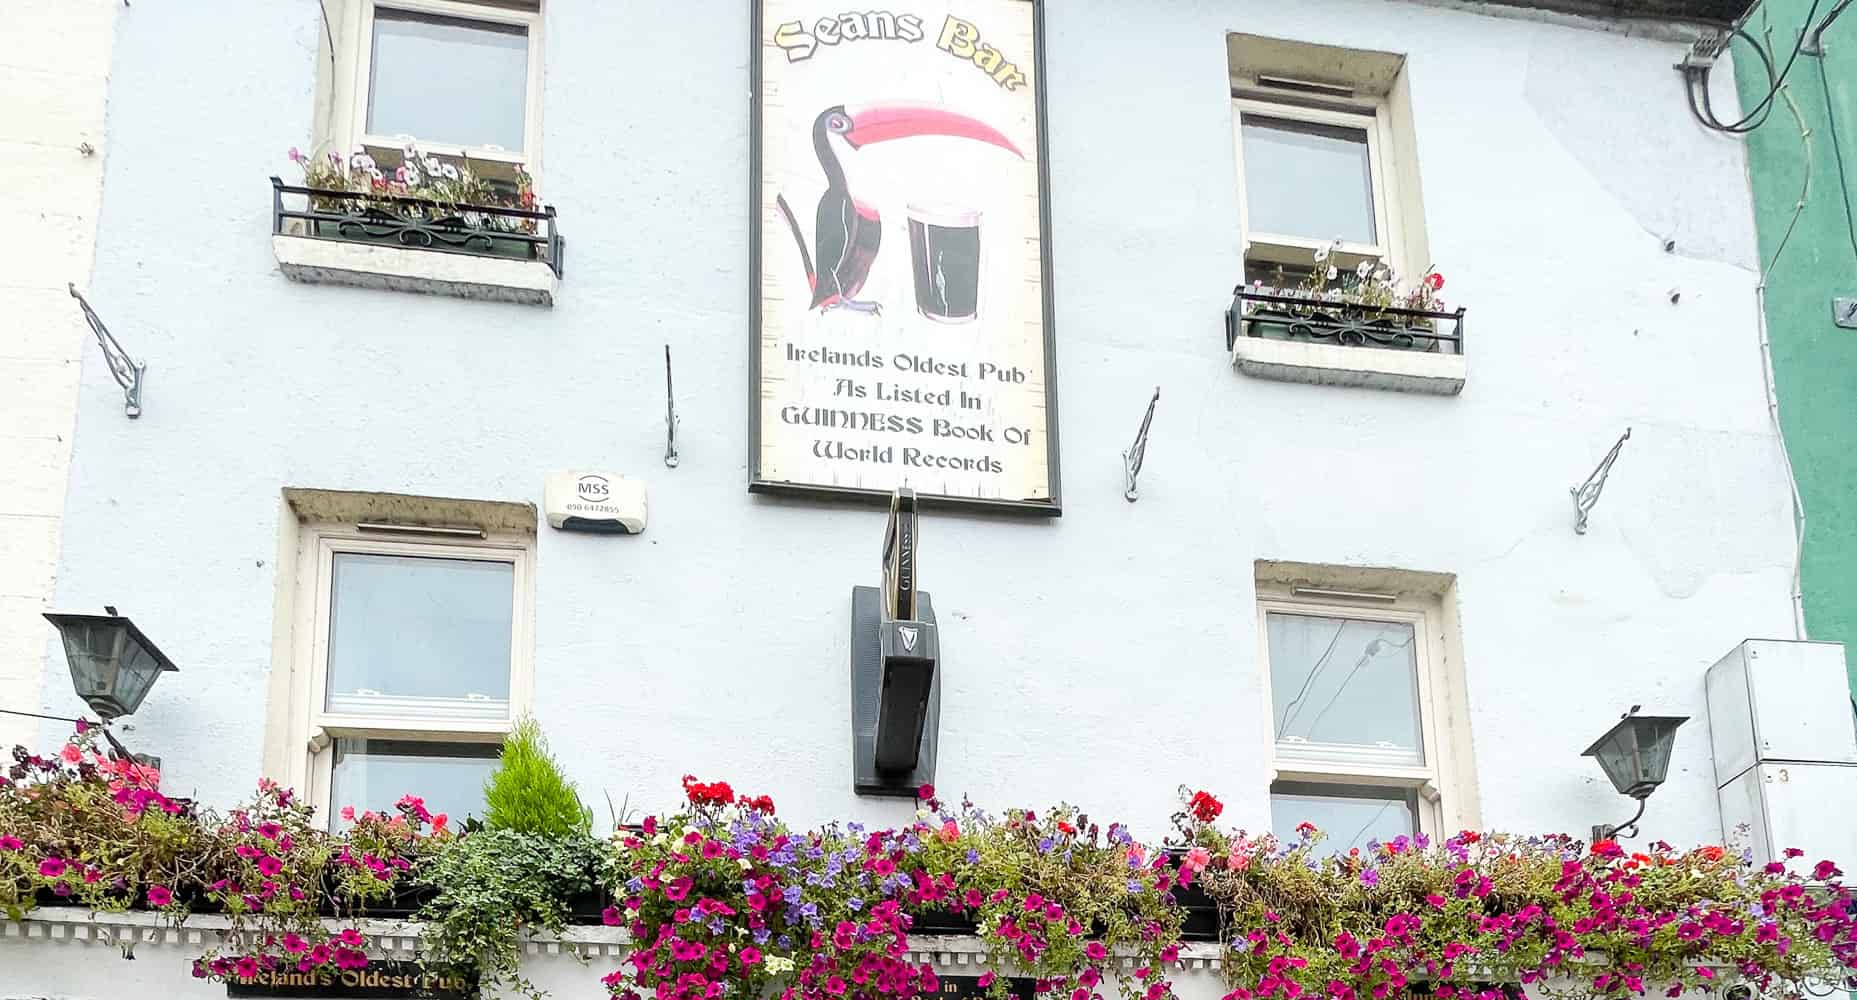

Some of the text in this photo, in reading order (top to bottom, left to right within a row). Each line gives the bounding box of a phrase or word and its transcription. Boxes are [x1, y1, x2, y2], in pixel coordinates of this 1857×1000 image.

[774, 10, 1027, 91] Seans Bar
[786, 342, 1026, 384] Irelands Oldest Pub
[833, 378, 982, 410] As Listed In
[781, 405, 1031, 446] GUINNESS Book Of
[812, 439, 1003, 473] World Records
[578, 482, 609, 495] MSS
[239, 968, 332, 987] Irelands
[341, 969, 413, 988] Oldest
[944, 980, 957, 993] in
